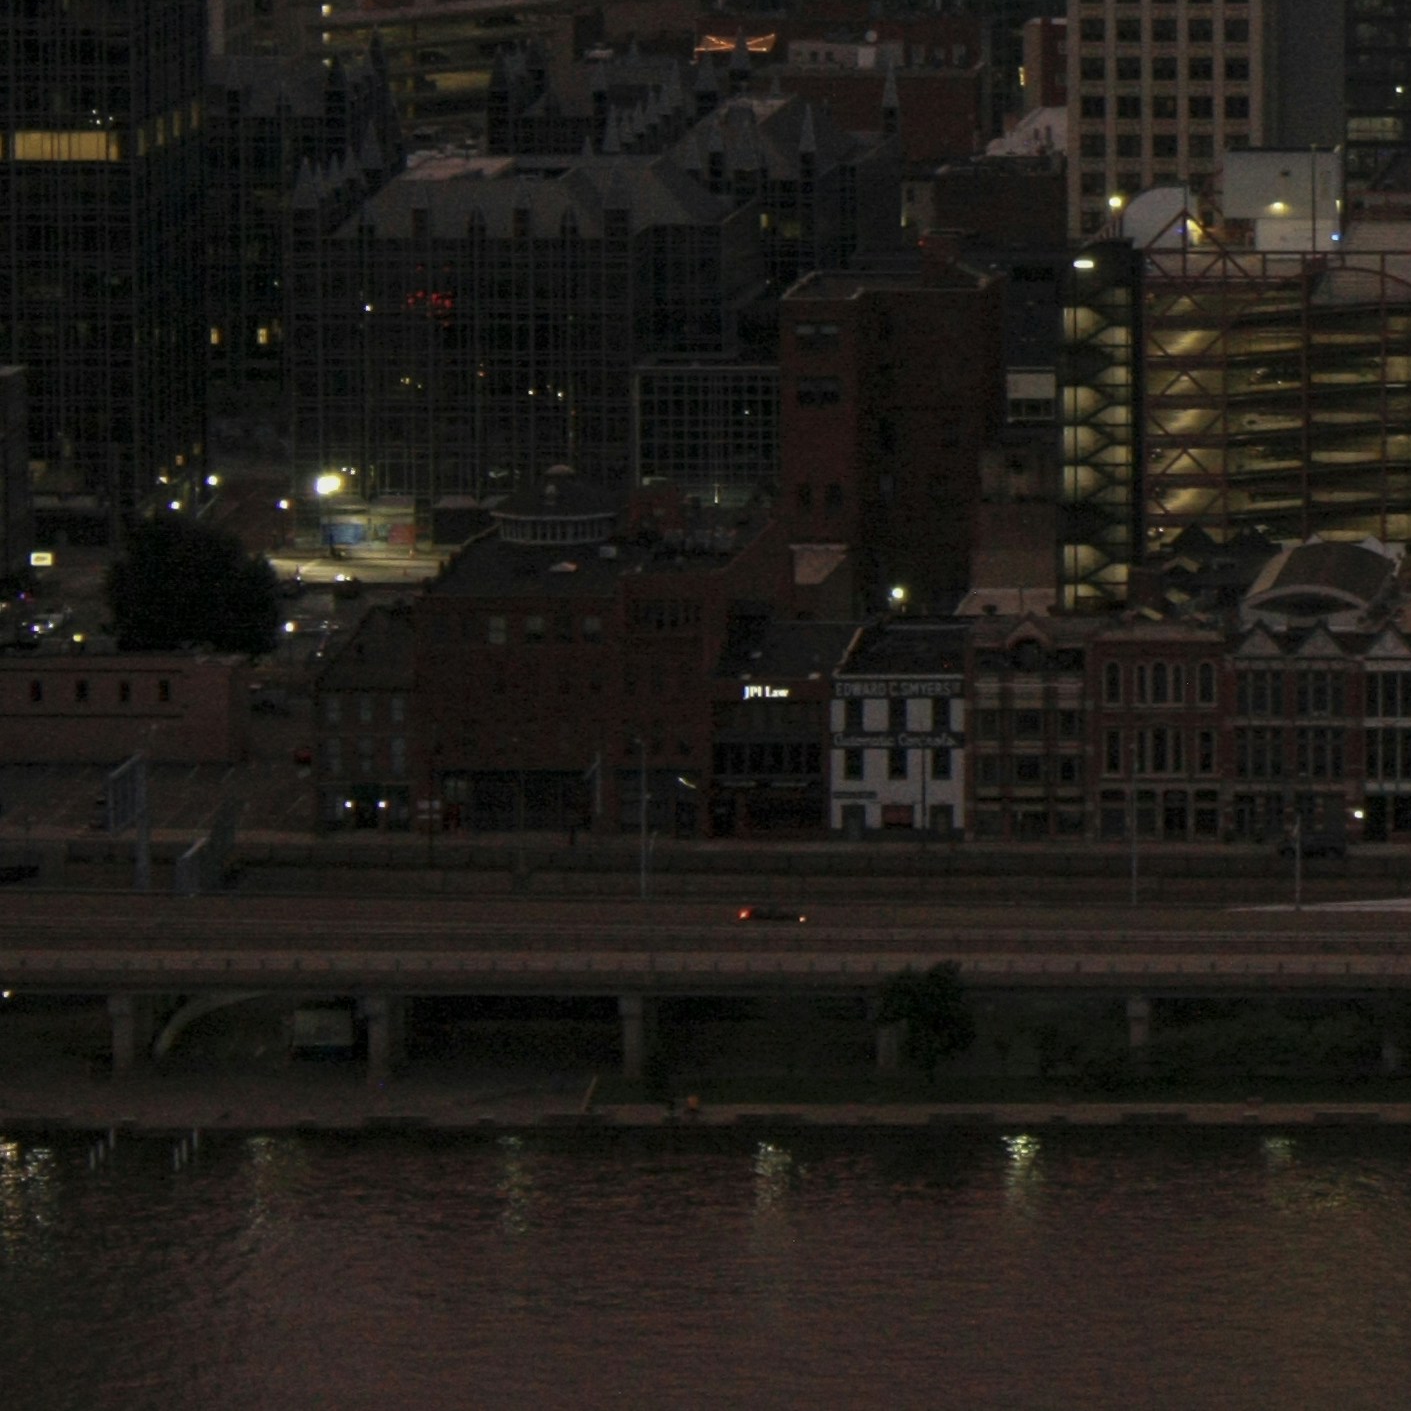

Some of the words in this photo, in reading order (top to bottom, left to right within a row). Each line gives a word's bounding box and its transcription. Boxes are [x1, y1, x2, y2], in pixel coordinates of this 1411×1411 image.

[765, 685, 789, 698] Law
[835, 681, 887, 697] EDWARD
[900, 681, 952, 697] SMYERS
